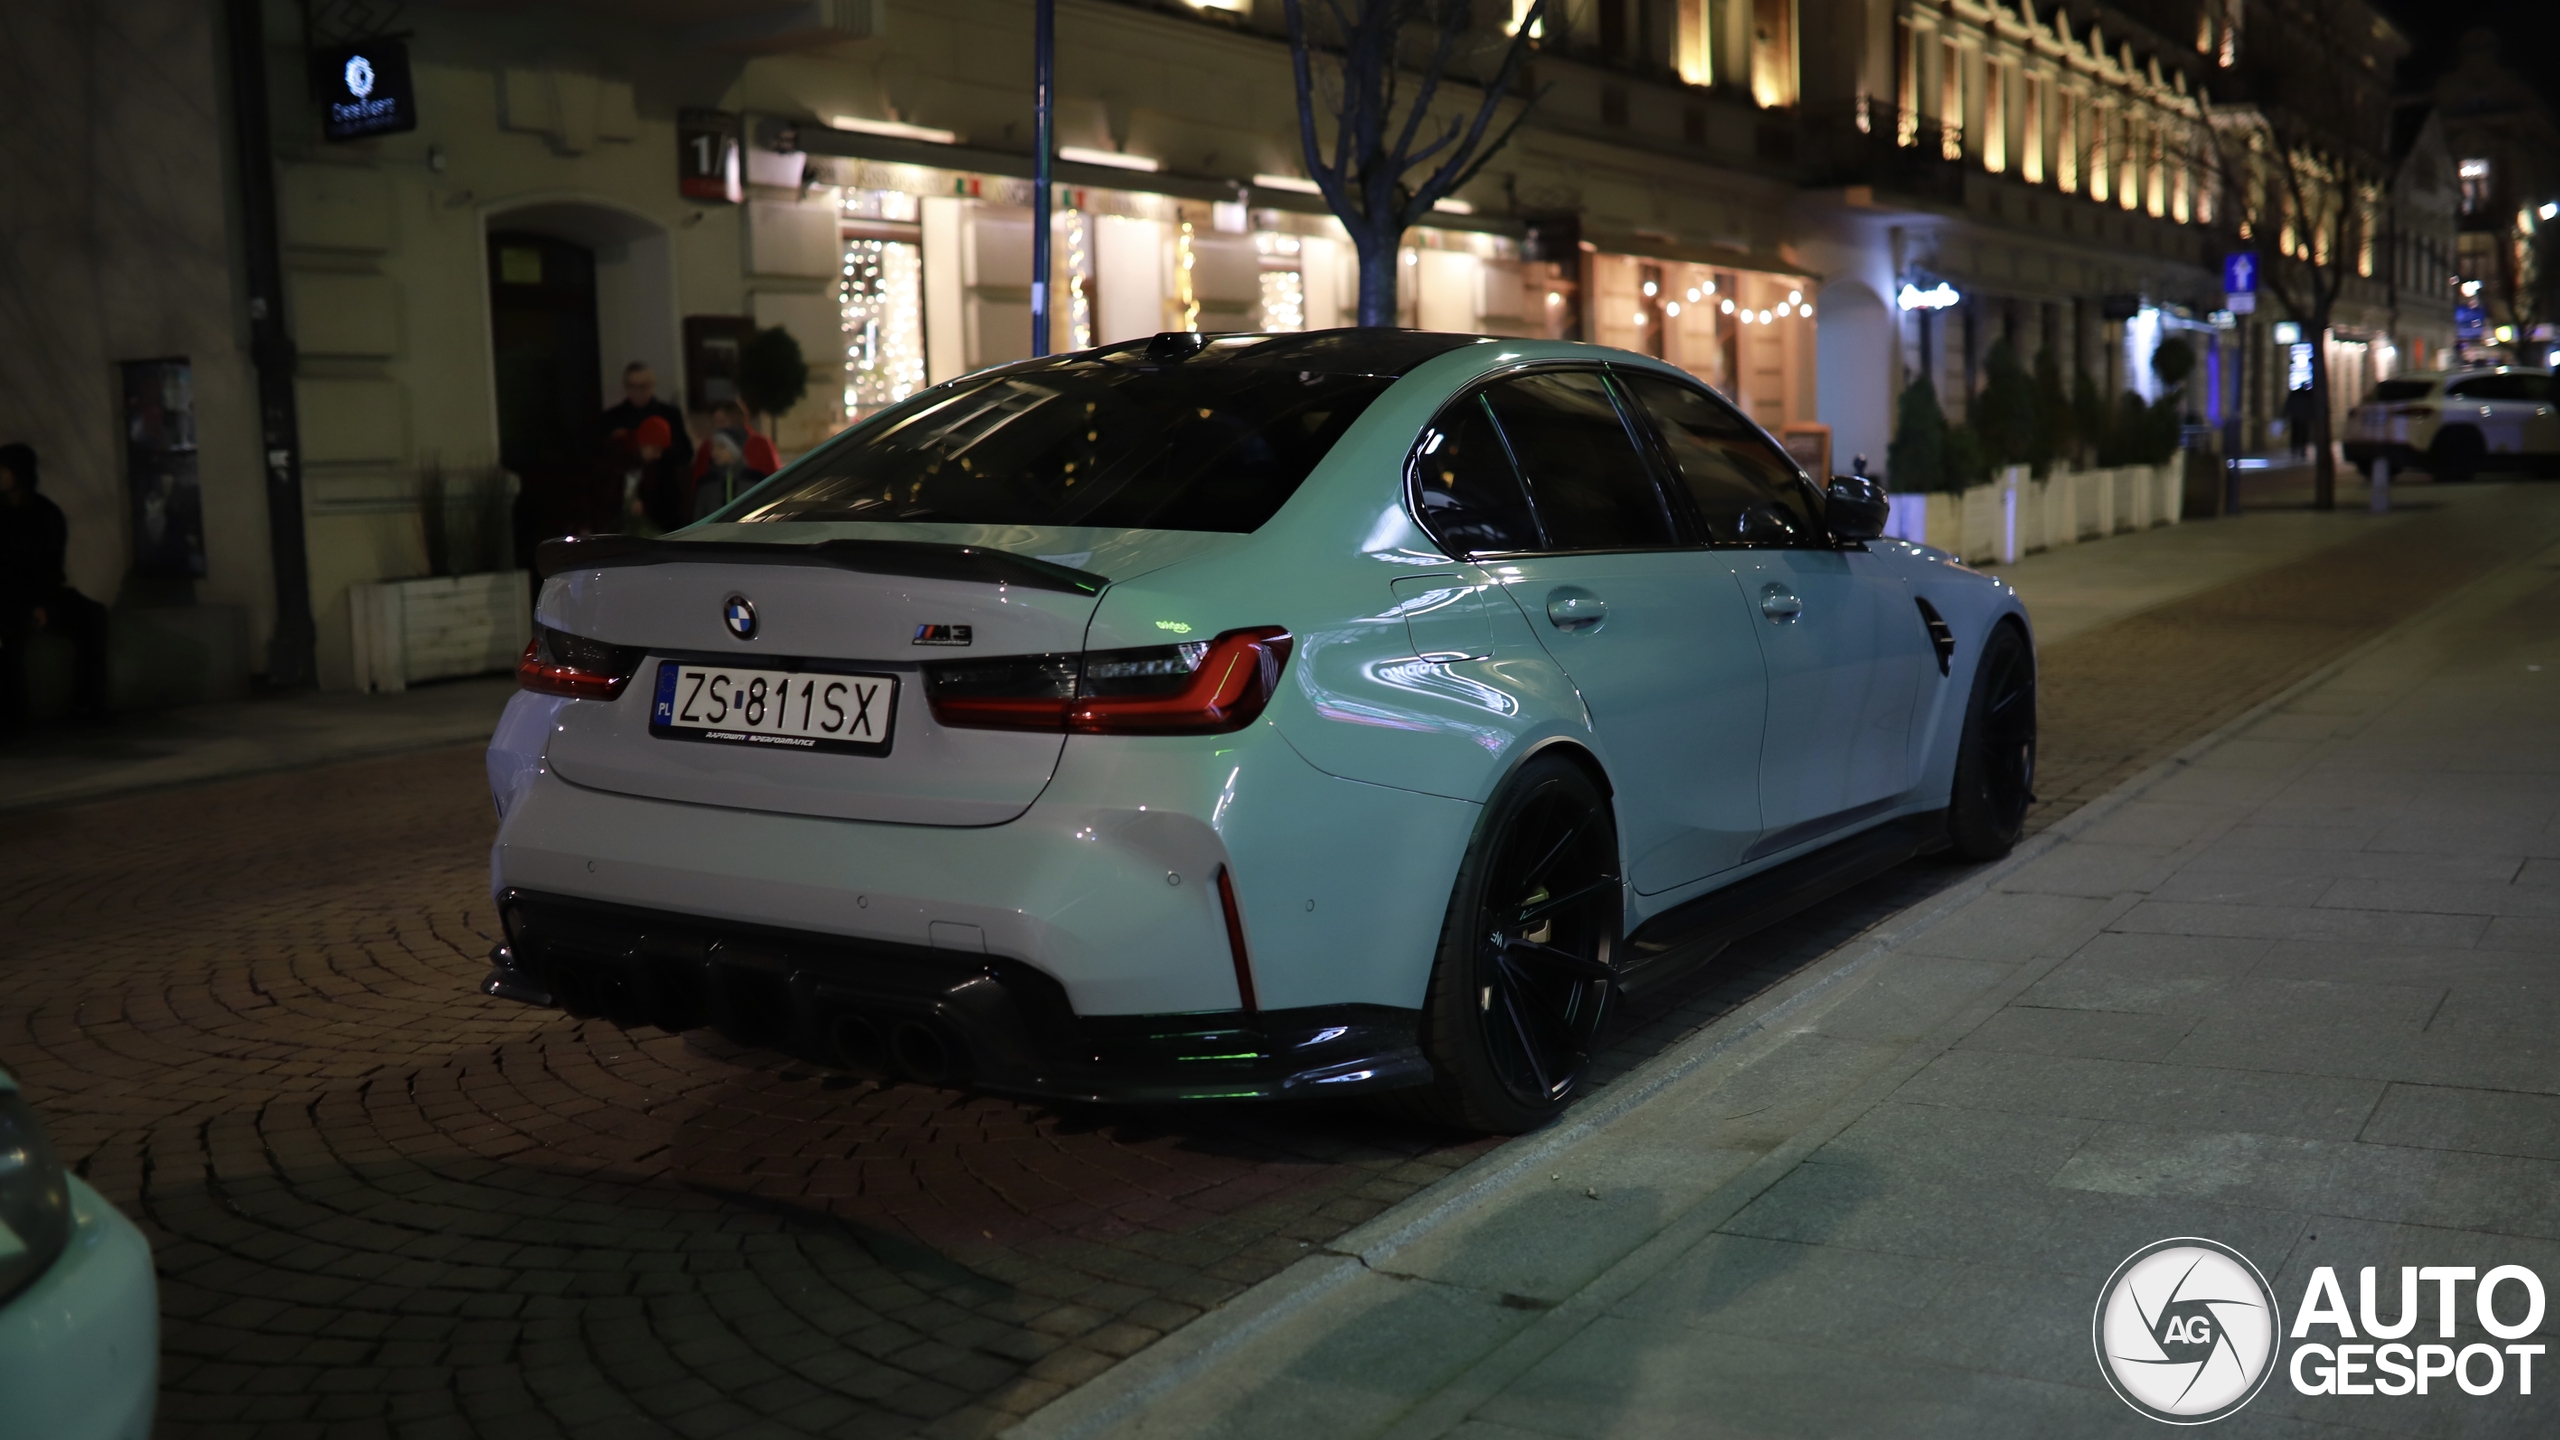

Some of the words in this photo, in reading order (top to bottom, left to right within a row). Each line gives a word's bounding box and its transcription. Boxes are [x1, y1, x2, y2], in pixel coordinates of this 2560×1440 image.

[658, 702, 671, 716] PL
[679, 672, 733, 724] ZS
[744, 677, 880, 737] 811SX
